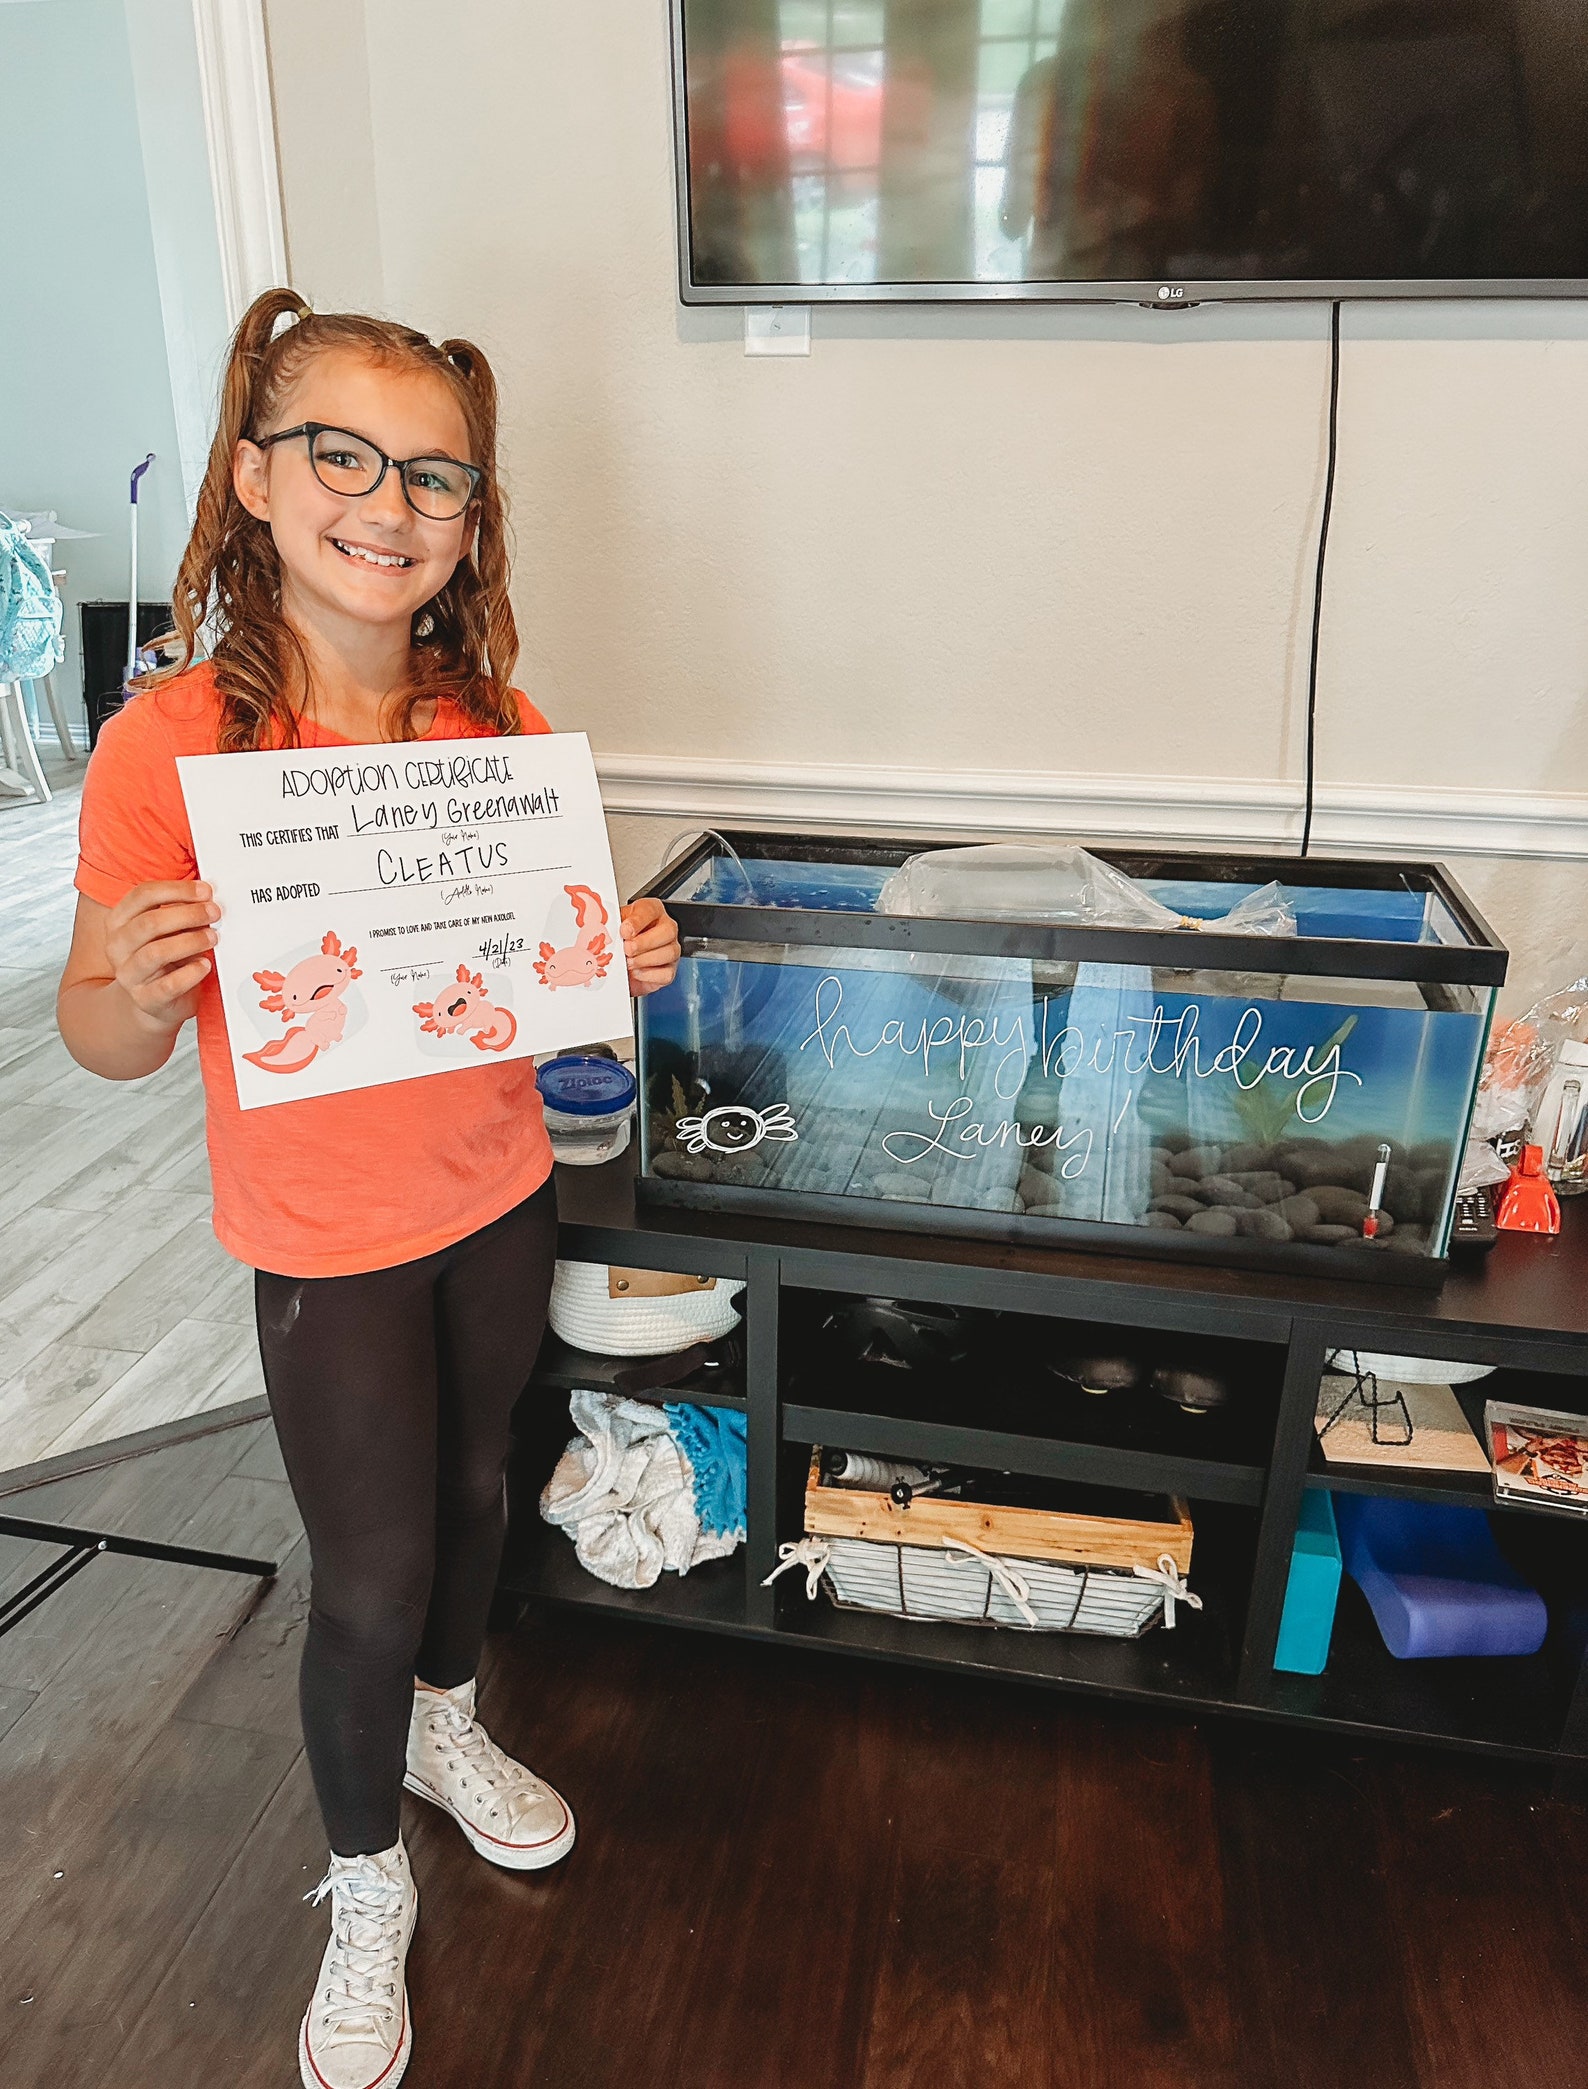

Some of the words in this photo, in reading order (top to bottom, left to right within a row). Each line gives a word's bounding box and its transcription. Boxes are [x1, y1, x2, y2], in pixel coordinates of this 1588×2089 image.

[1170, 288, 1183, 298] LG
[239, 832, 263, 848] THIS
[266, 827, 313, 846] CERTIFIES
[315, 825, 340, 841] THAT
[351, 802, 438, 833] Laney
[250, 887, 273, 904] HAS
[276, 882, 321, 901] ADOPTED
[377, 842, 508, 885] CLEATUS
[372, 927, 397, 938] PROMISE
[398, 926, 406, 935] TO
[406, 924, 420, 934] LOVE
[420, 922, 433, 932] AND
[433, 921, 447, 930] TAKE
[448, 918, 463, 929] CARE
[463, 917, 471, 927] OF
[472, 916, 480, 925] MY
[481, 914, 493, 924] NEW
[478, 932, 525, 965] 4/21/23
[800, 976, 1028, 1100] happy
[1042, 995, 1363, 1124] birthday
